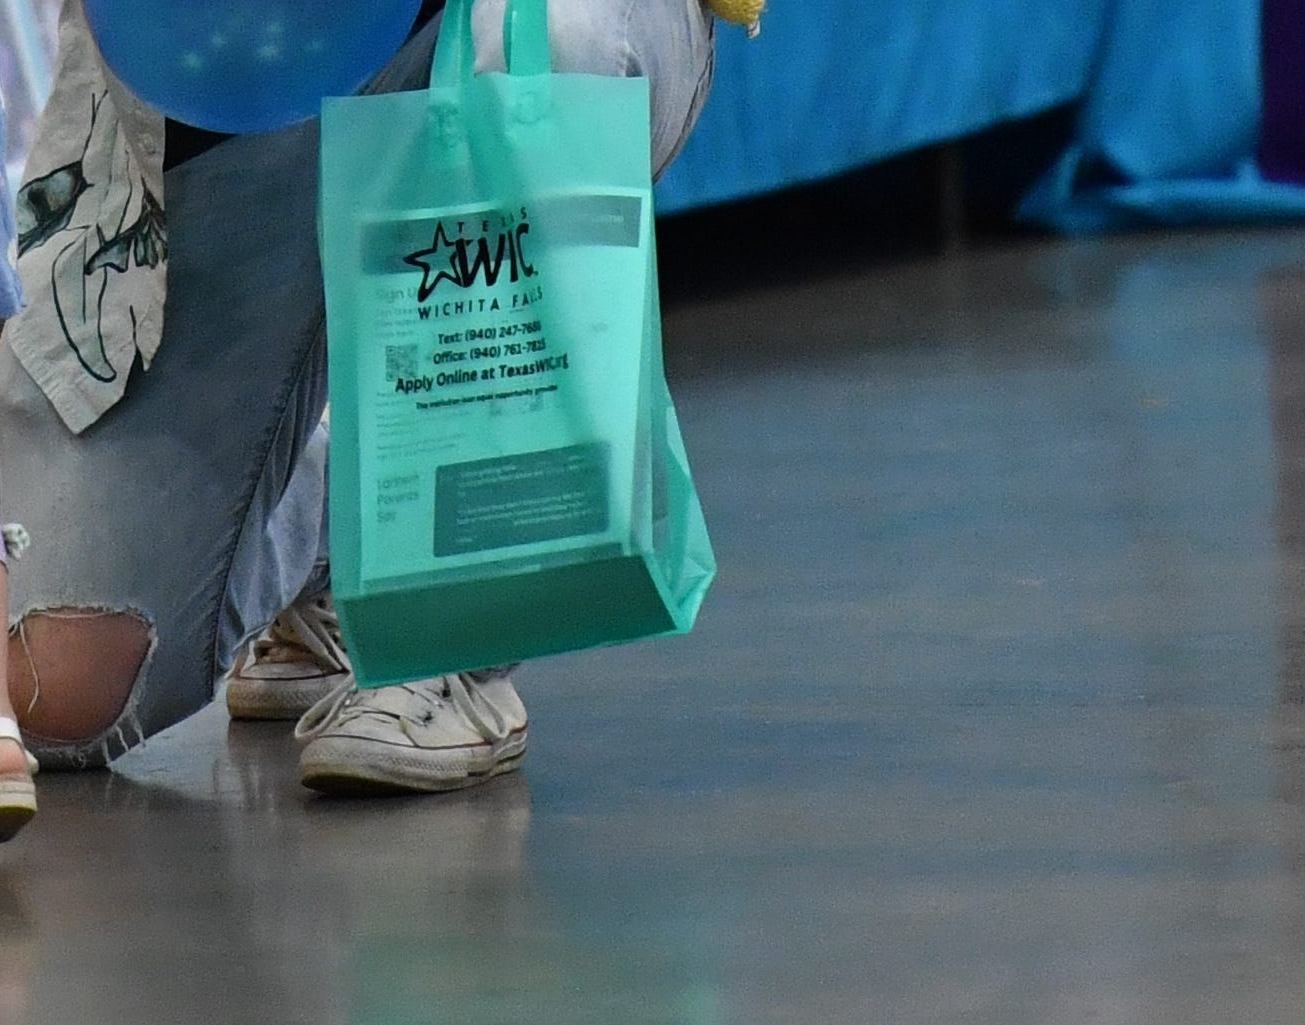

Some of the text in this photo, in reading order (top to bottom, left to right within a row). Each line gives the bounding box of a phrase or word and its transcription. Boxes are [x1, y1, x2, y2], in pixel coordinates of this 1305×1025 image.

[417, 297, 500, 320] WICHITA
[437, 332, 463, 345] Text:
[465, 327, 497, 342] (940)
[433, 350, 467, 365] Office:
[470, 345, 501, 361] (940)
[395, 375, 434, 394] Apply
[436, 368, 478, 387] Online
[480, 367, 496, 381] at
